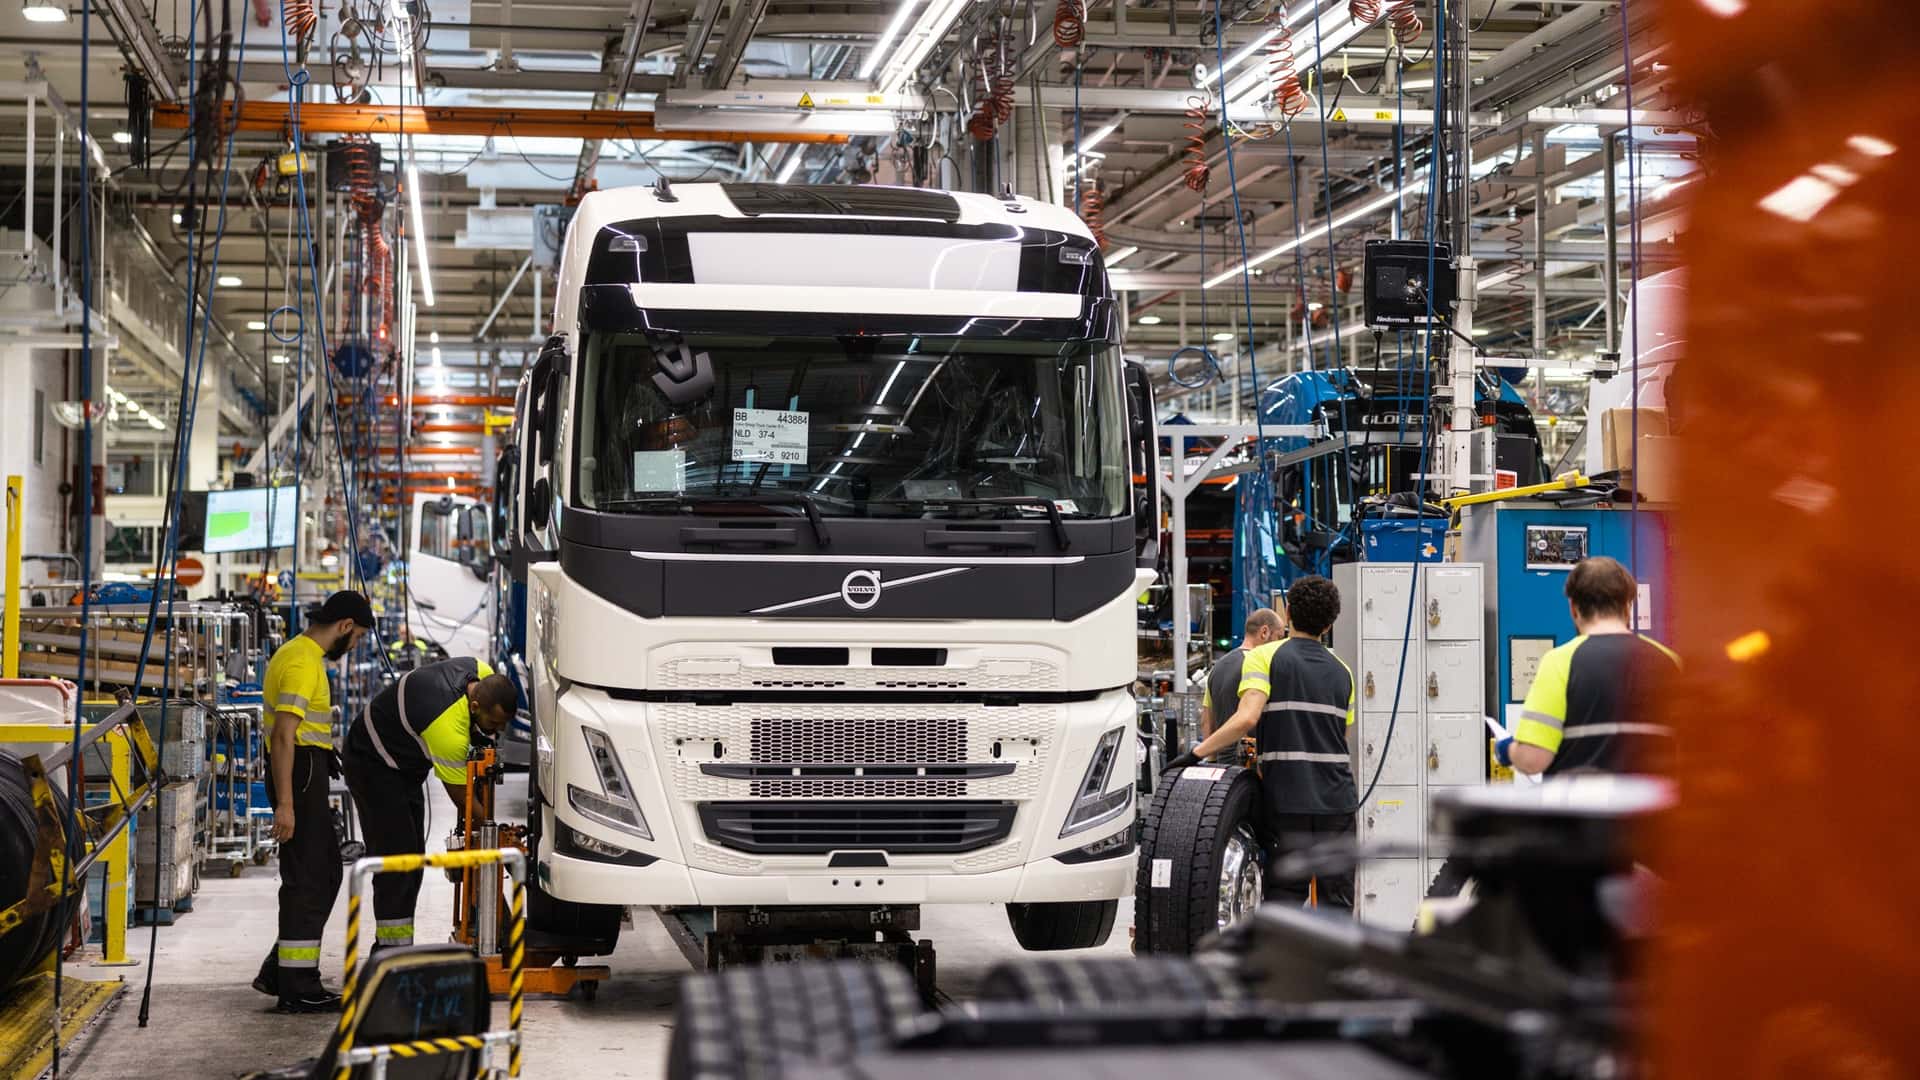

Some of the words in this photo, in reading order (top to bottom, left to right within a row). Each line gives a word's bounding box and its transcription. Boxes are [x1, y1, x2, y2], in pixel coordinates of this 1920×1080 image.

[735, 411, 748, 421] BB
[777, 412, 808, 424] 443884
[734, 429, 751, 438] NLD
[758, 430, 775, 439] 37-4
[733, 448, 743, 457] 53
[780, 451, 800, 461] 9210
